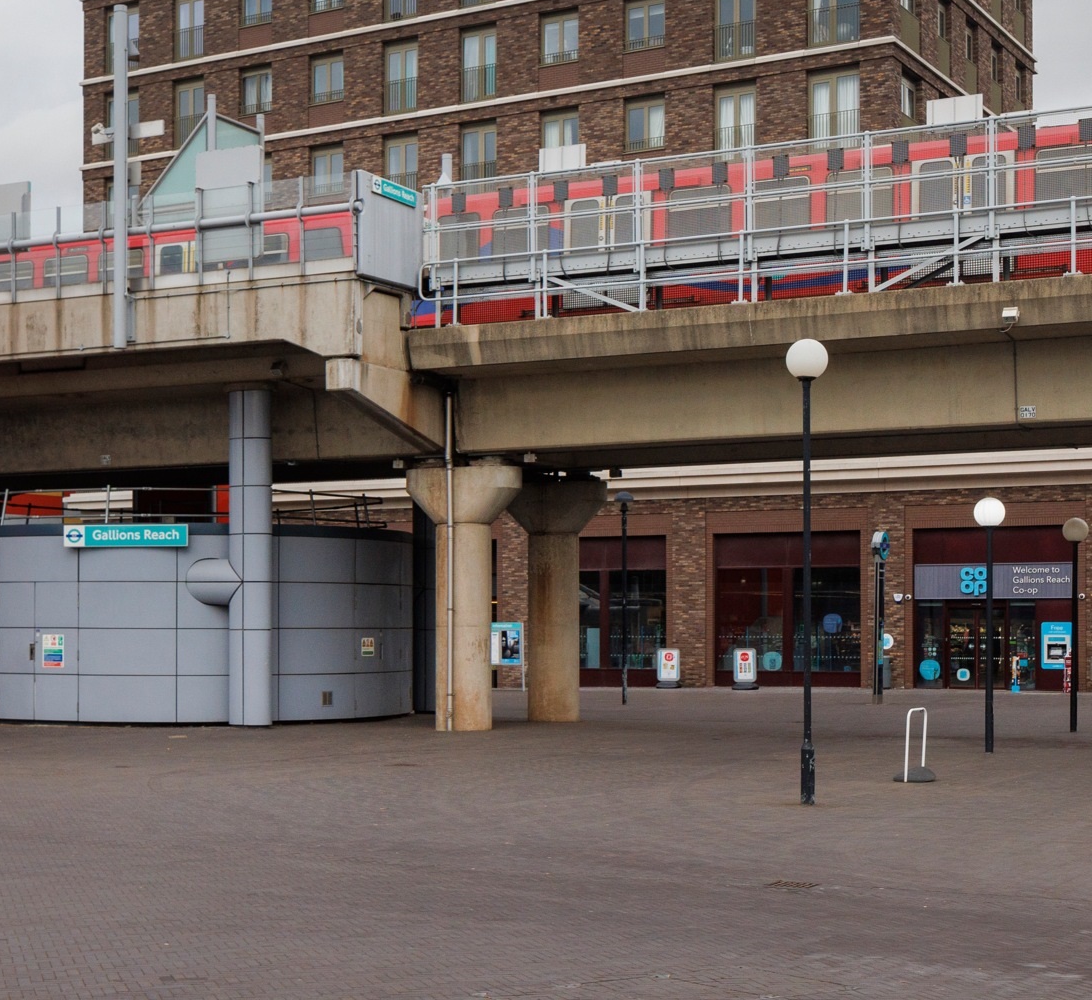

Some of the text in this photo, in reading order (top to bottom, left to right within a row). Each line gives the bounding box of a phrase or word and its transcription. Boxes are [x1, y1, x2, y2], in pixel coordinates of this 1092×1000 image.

[92, 529, 180, 541] Gallions Reach
[1012, 566, 1060, 574] Welcome to
[1012, 575, 1071, 584] Gallions Reach
[1012, 586, 1038, 595] Co-op
